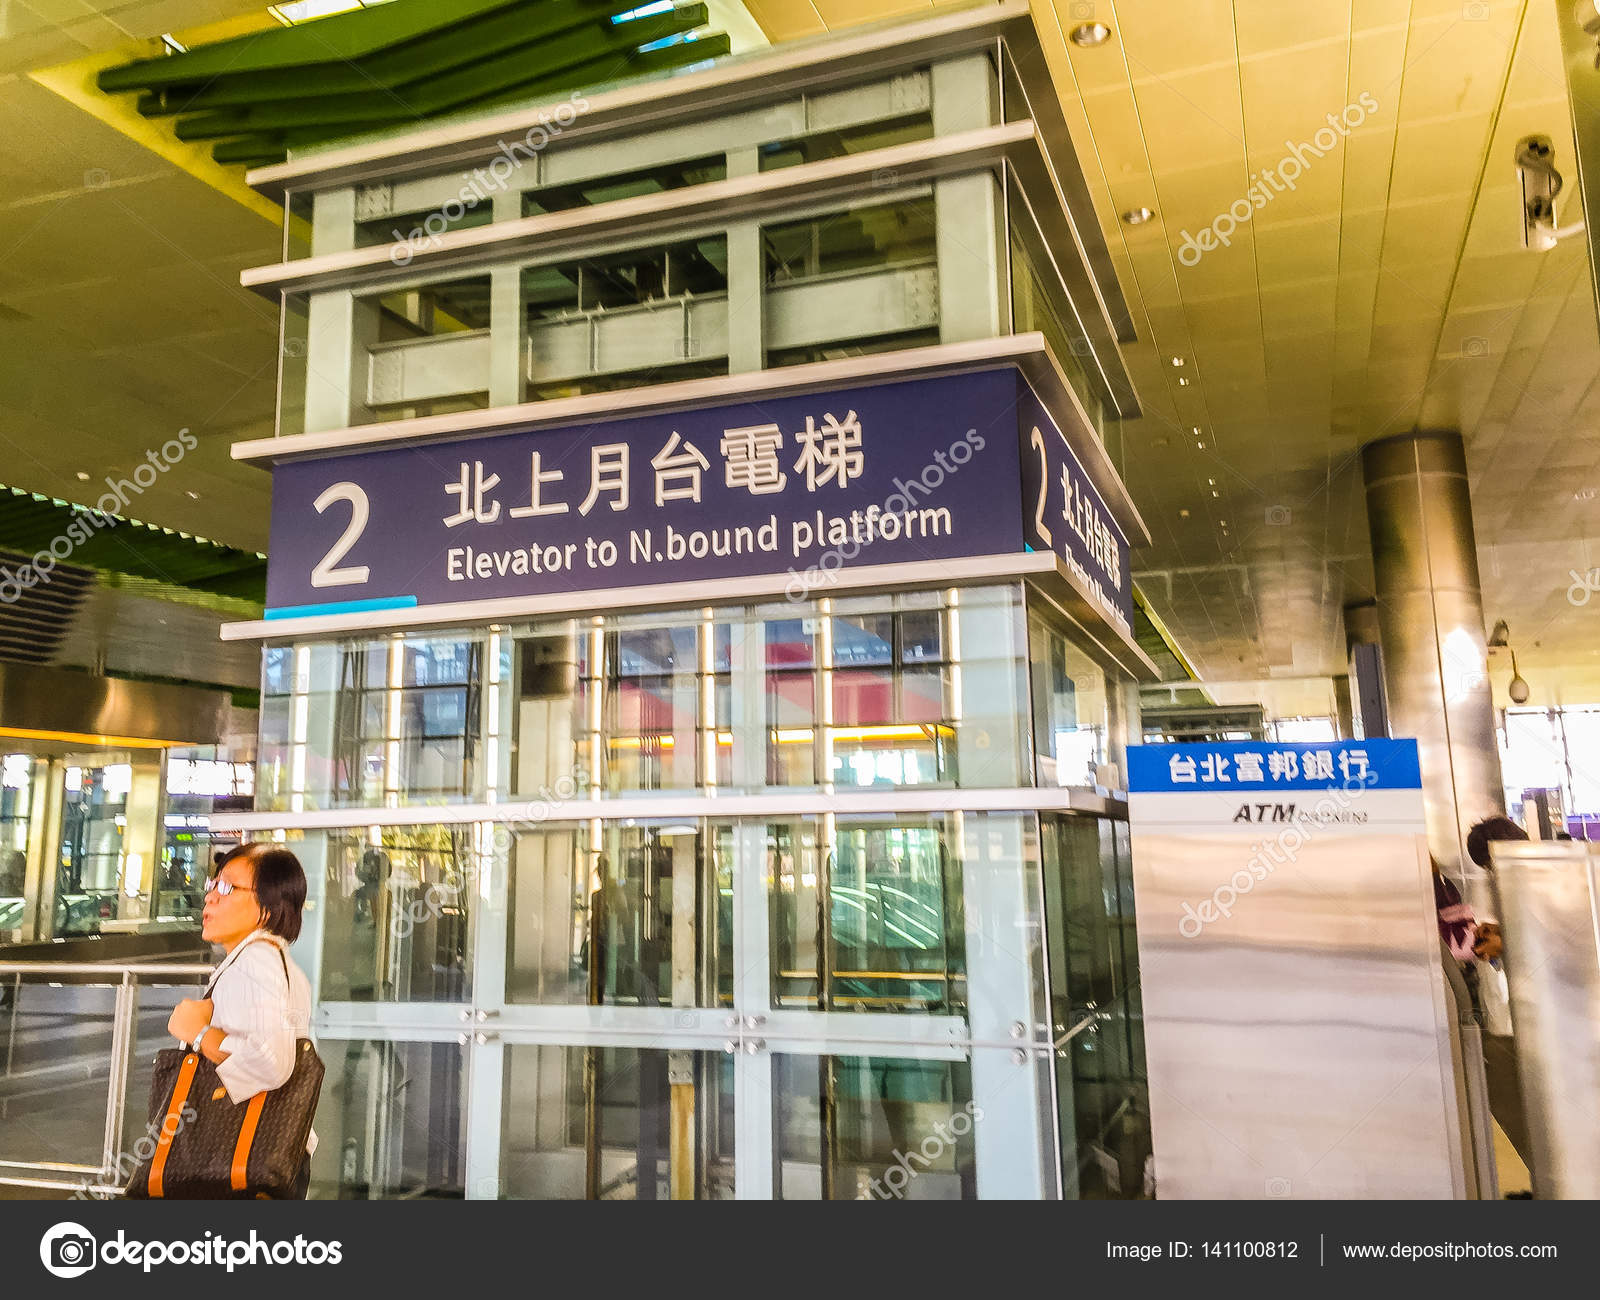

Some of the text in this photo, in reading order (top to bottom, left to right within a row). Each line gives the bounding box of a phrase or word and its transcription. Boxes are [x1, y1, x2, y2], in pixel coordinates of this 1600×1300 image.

[442, 409, 865, 528] 北上月台電梯
[1030, 425, 1053, 548] 2
[310, 481, 371, 589] 2
[447, 504, 953, 581] Elevator to N.bound platform
[1168, 749, 1370, 784] 台北富邦銀行
[1233, 804, 1296, 824] ATM
